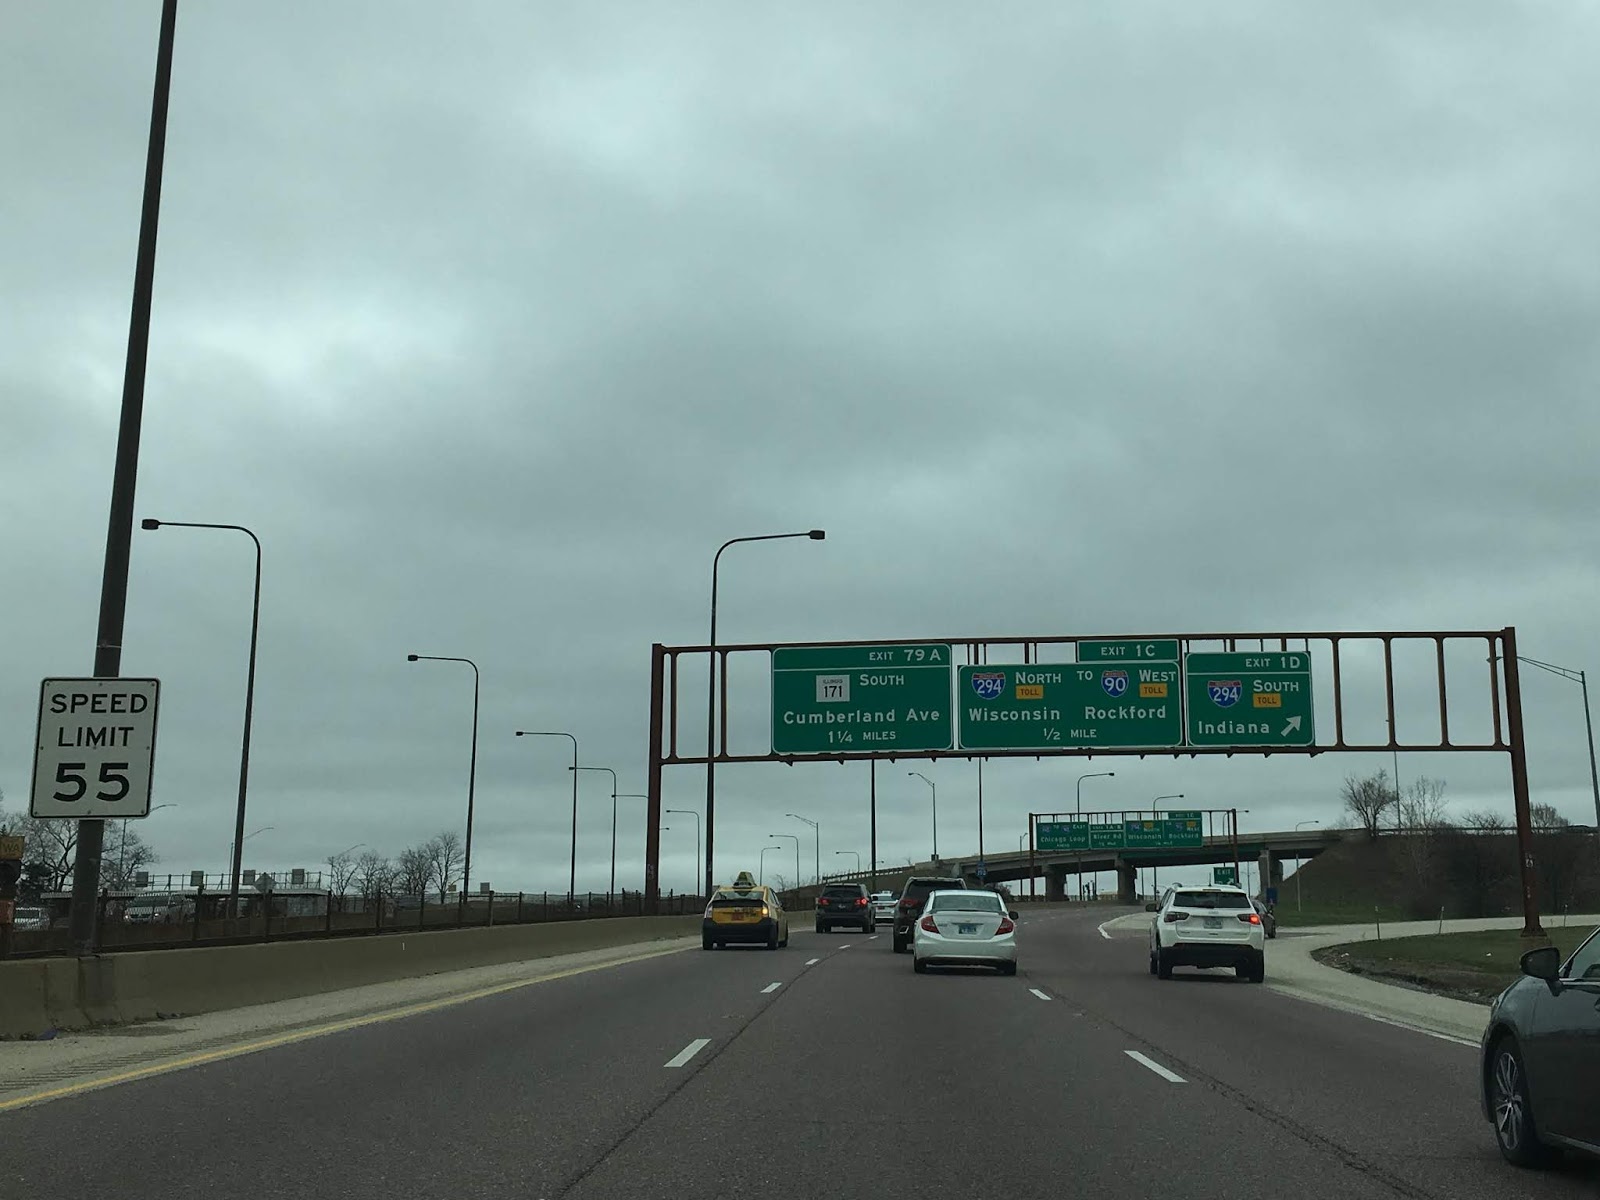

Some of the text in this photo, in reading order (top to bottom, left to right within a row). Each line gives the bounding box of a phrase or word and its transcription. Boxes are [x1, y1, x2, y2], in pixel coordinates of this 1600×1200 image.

[869, 651, 894, 661] EXIT
[1101, 646, 1126, 656] EXIT
[1245, 658, 1271, 668] EXIT
[859, 674, 905, 686] SOUTH
[1015, 671, 1062, 684] NORTH
[1076, 670, 1094, 681] TO
[1138, 669, 1177, 682] WEST
[977, 679, 1002, 694] 294
[1104, 677, 1126, 692] 90
[1143, 686, 1163, 694] TOLL
[1252, 679, 1300, 692] SOUTH
[823, 685, 843, 698] 171
[1020, 687, 1040, 696] TOLL
[1212, 687, 1239, 702] 294
[50, 693, 148, 714] SPEED
[1257, 696, 1277, 705] TOLL
[783, 708, 940, 725] Cumberland Ave
[969, 705, 1167, 722] Wisconsin Rockford
[1198, 720, 1270, 734] Indiana
[57, 726, 134, 747] LIMIT
[862, 731, 897, 741] MILES
[1070, 729, 1097, 739] MILE
[53, 762, 130, 802] 55
